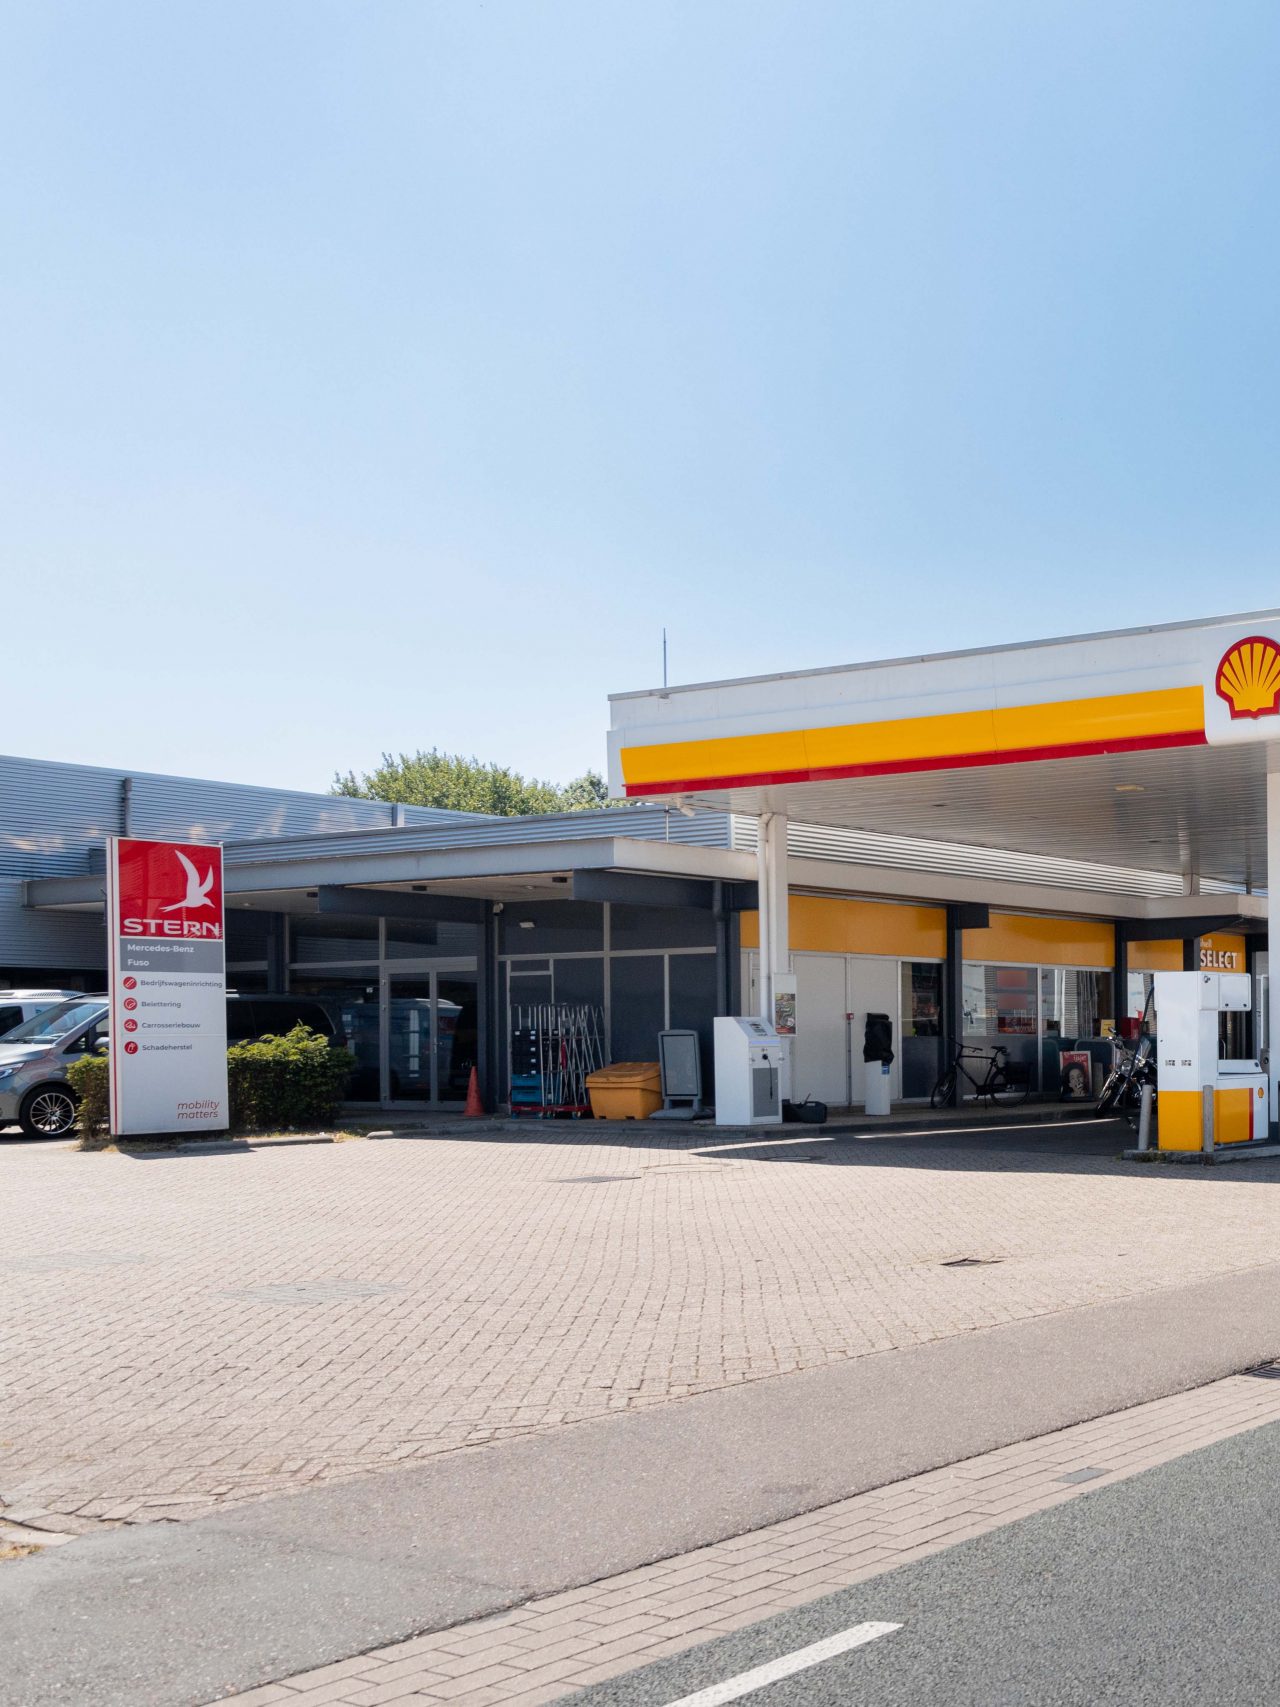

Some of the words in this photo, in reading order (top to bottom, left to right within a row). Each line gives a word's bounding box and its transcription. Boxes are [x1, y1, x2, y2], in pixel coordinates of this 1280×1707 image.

[123, 918, 220, 936] STERN
[127, 944, 195, 953] Mercedes-Benz
[127, 958, 150, 966] Fuso
[1200, 949, 1238, 969] SELECT
[140, 980, 223, 988] Bedrijfswageninrichting
[177, 1100, 220, 1110] mobility
[177, 1110, 219, 1119] matters
